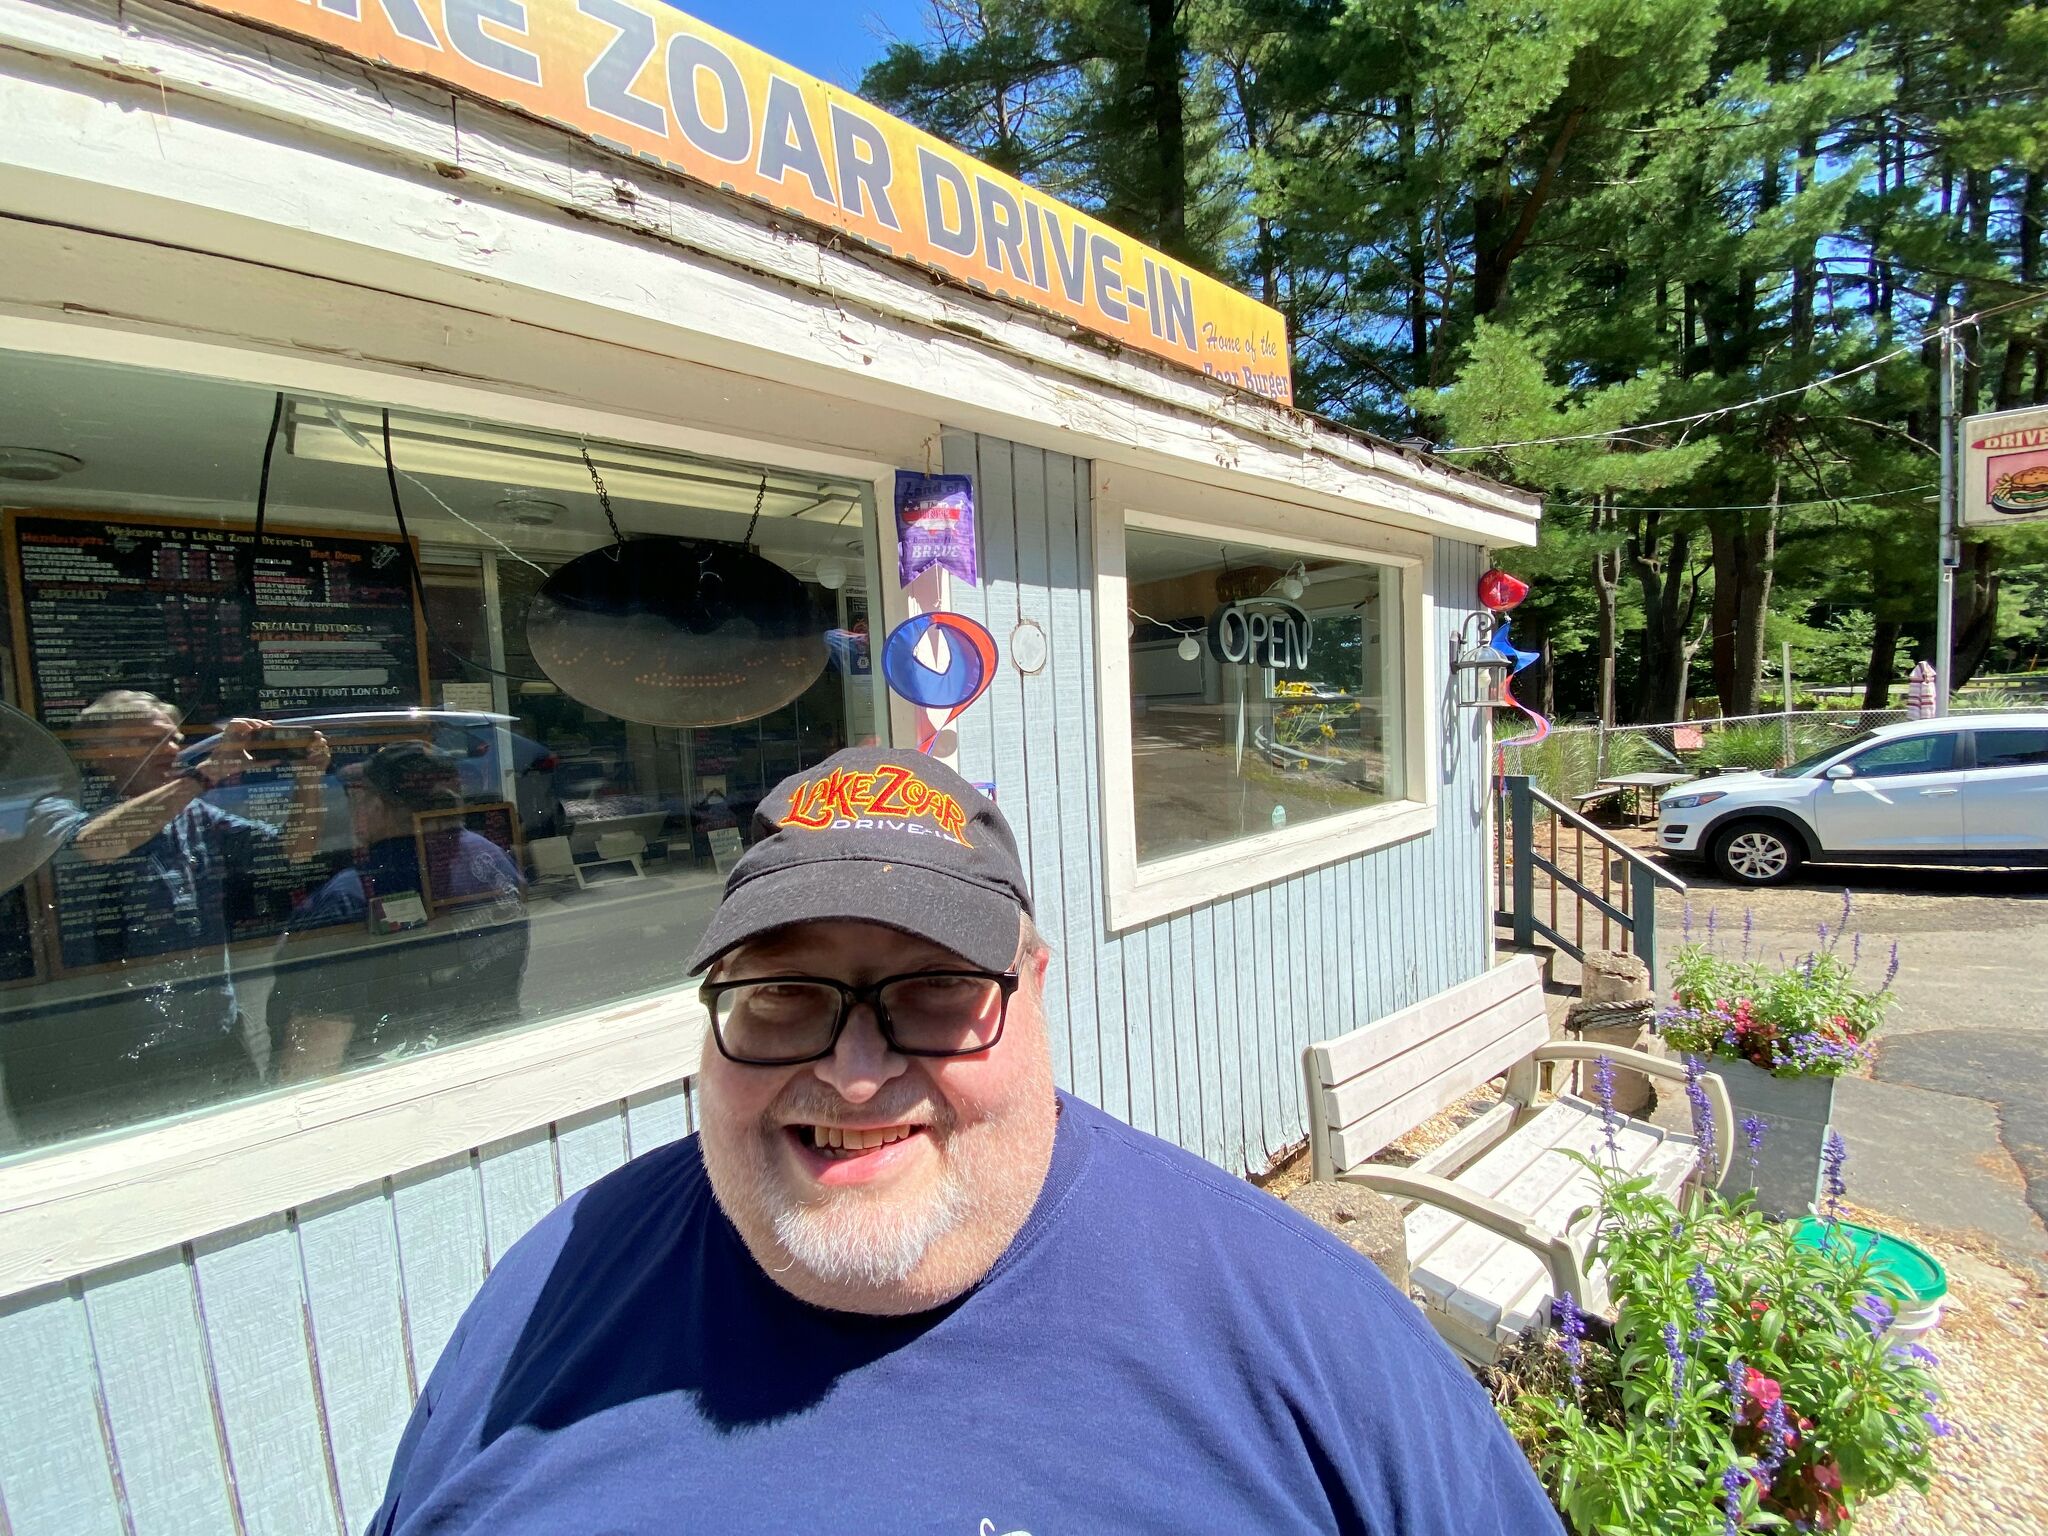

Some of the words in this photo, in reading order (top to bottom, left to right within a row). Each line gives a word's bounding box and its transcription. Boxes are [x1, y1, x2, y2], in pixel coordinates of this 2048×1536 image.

[575, 0, 902, 233] ZOAR
[916, 144, 1198, 352] DRIVE-IN
[1201, 321, 1242, 353] Home
[1245, 331, 1256, 363] of
[1260, 331, 1277, 358] the
[1241, 365, 1289, 401] Burger
[911, 544, 960, 559] BRAVE
[251, 622, 311, 631] SPECIALTY
[314, 623, 364, 633] HOTDOGS
[1219, 607, 1308, 670] OPEN
[258, 689, 320, 698] SPECIALTY
[322, 688, 349, 697] FOOT
[351, 687, 379, 696] LONG
[777, 766, 876, 831] LAKE
[863, 764, 975, 850] ZOAR
